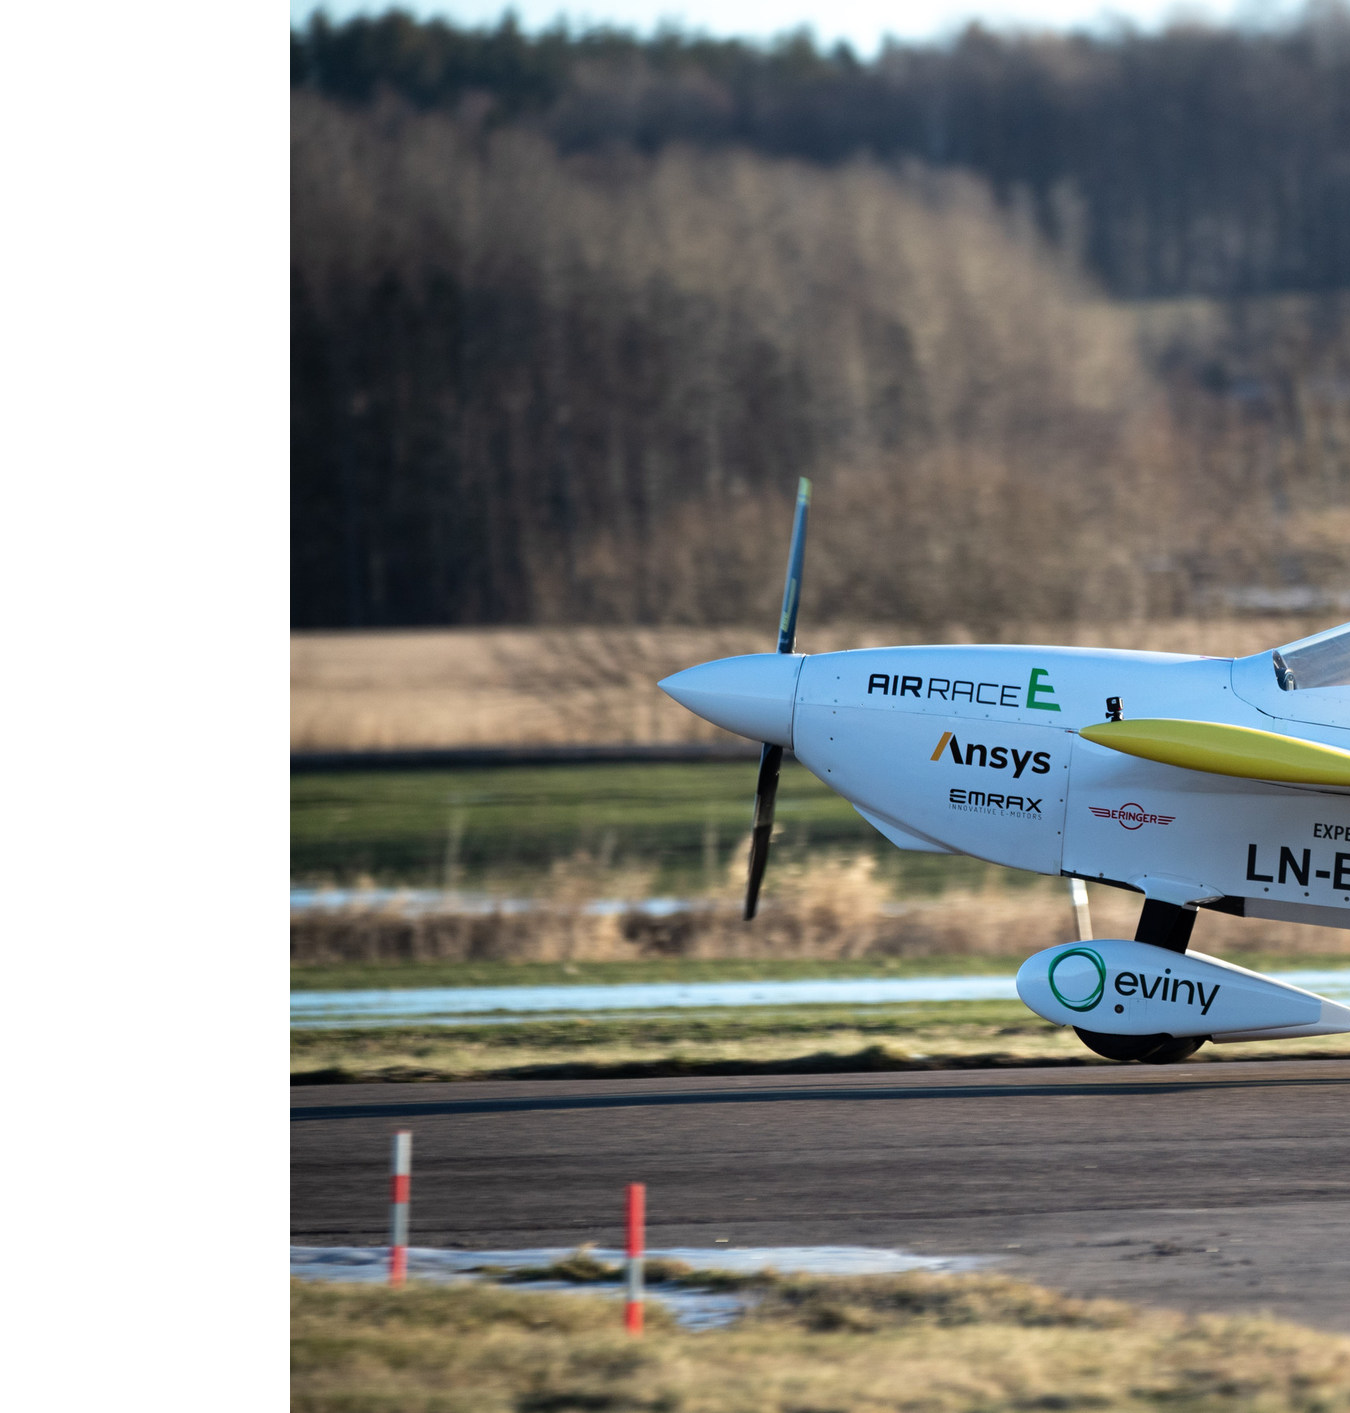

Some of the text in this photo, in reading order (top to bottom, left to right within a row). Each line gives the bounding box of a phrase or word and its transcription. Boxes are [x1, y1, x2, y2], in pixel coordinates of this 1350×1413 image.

[867, 673, 923, 698] AIR
[927, 677, 1022, 708] RACE
[929, 731, 1051, 779] Ansys
[948, 803, 1043, 821] INNOVATIVE E-MOTORS
[949, 788, 1043, 814] EMRAX
[1088, 806, 1158, 825] BERINGER
[1114, 967, 1221, 1016] eviny
